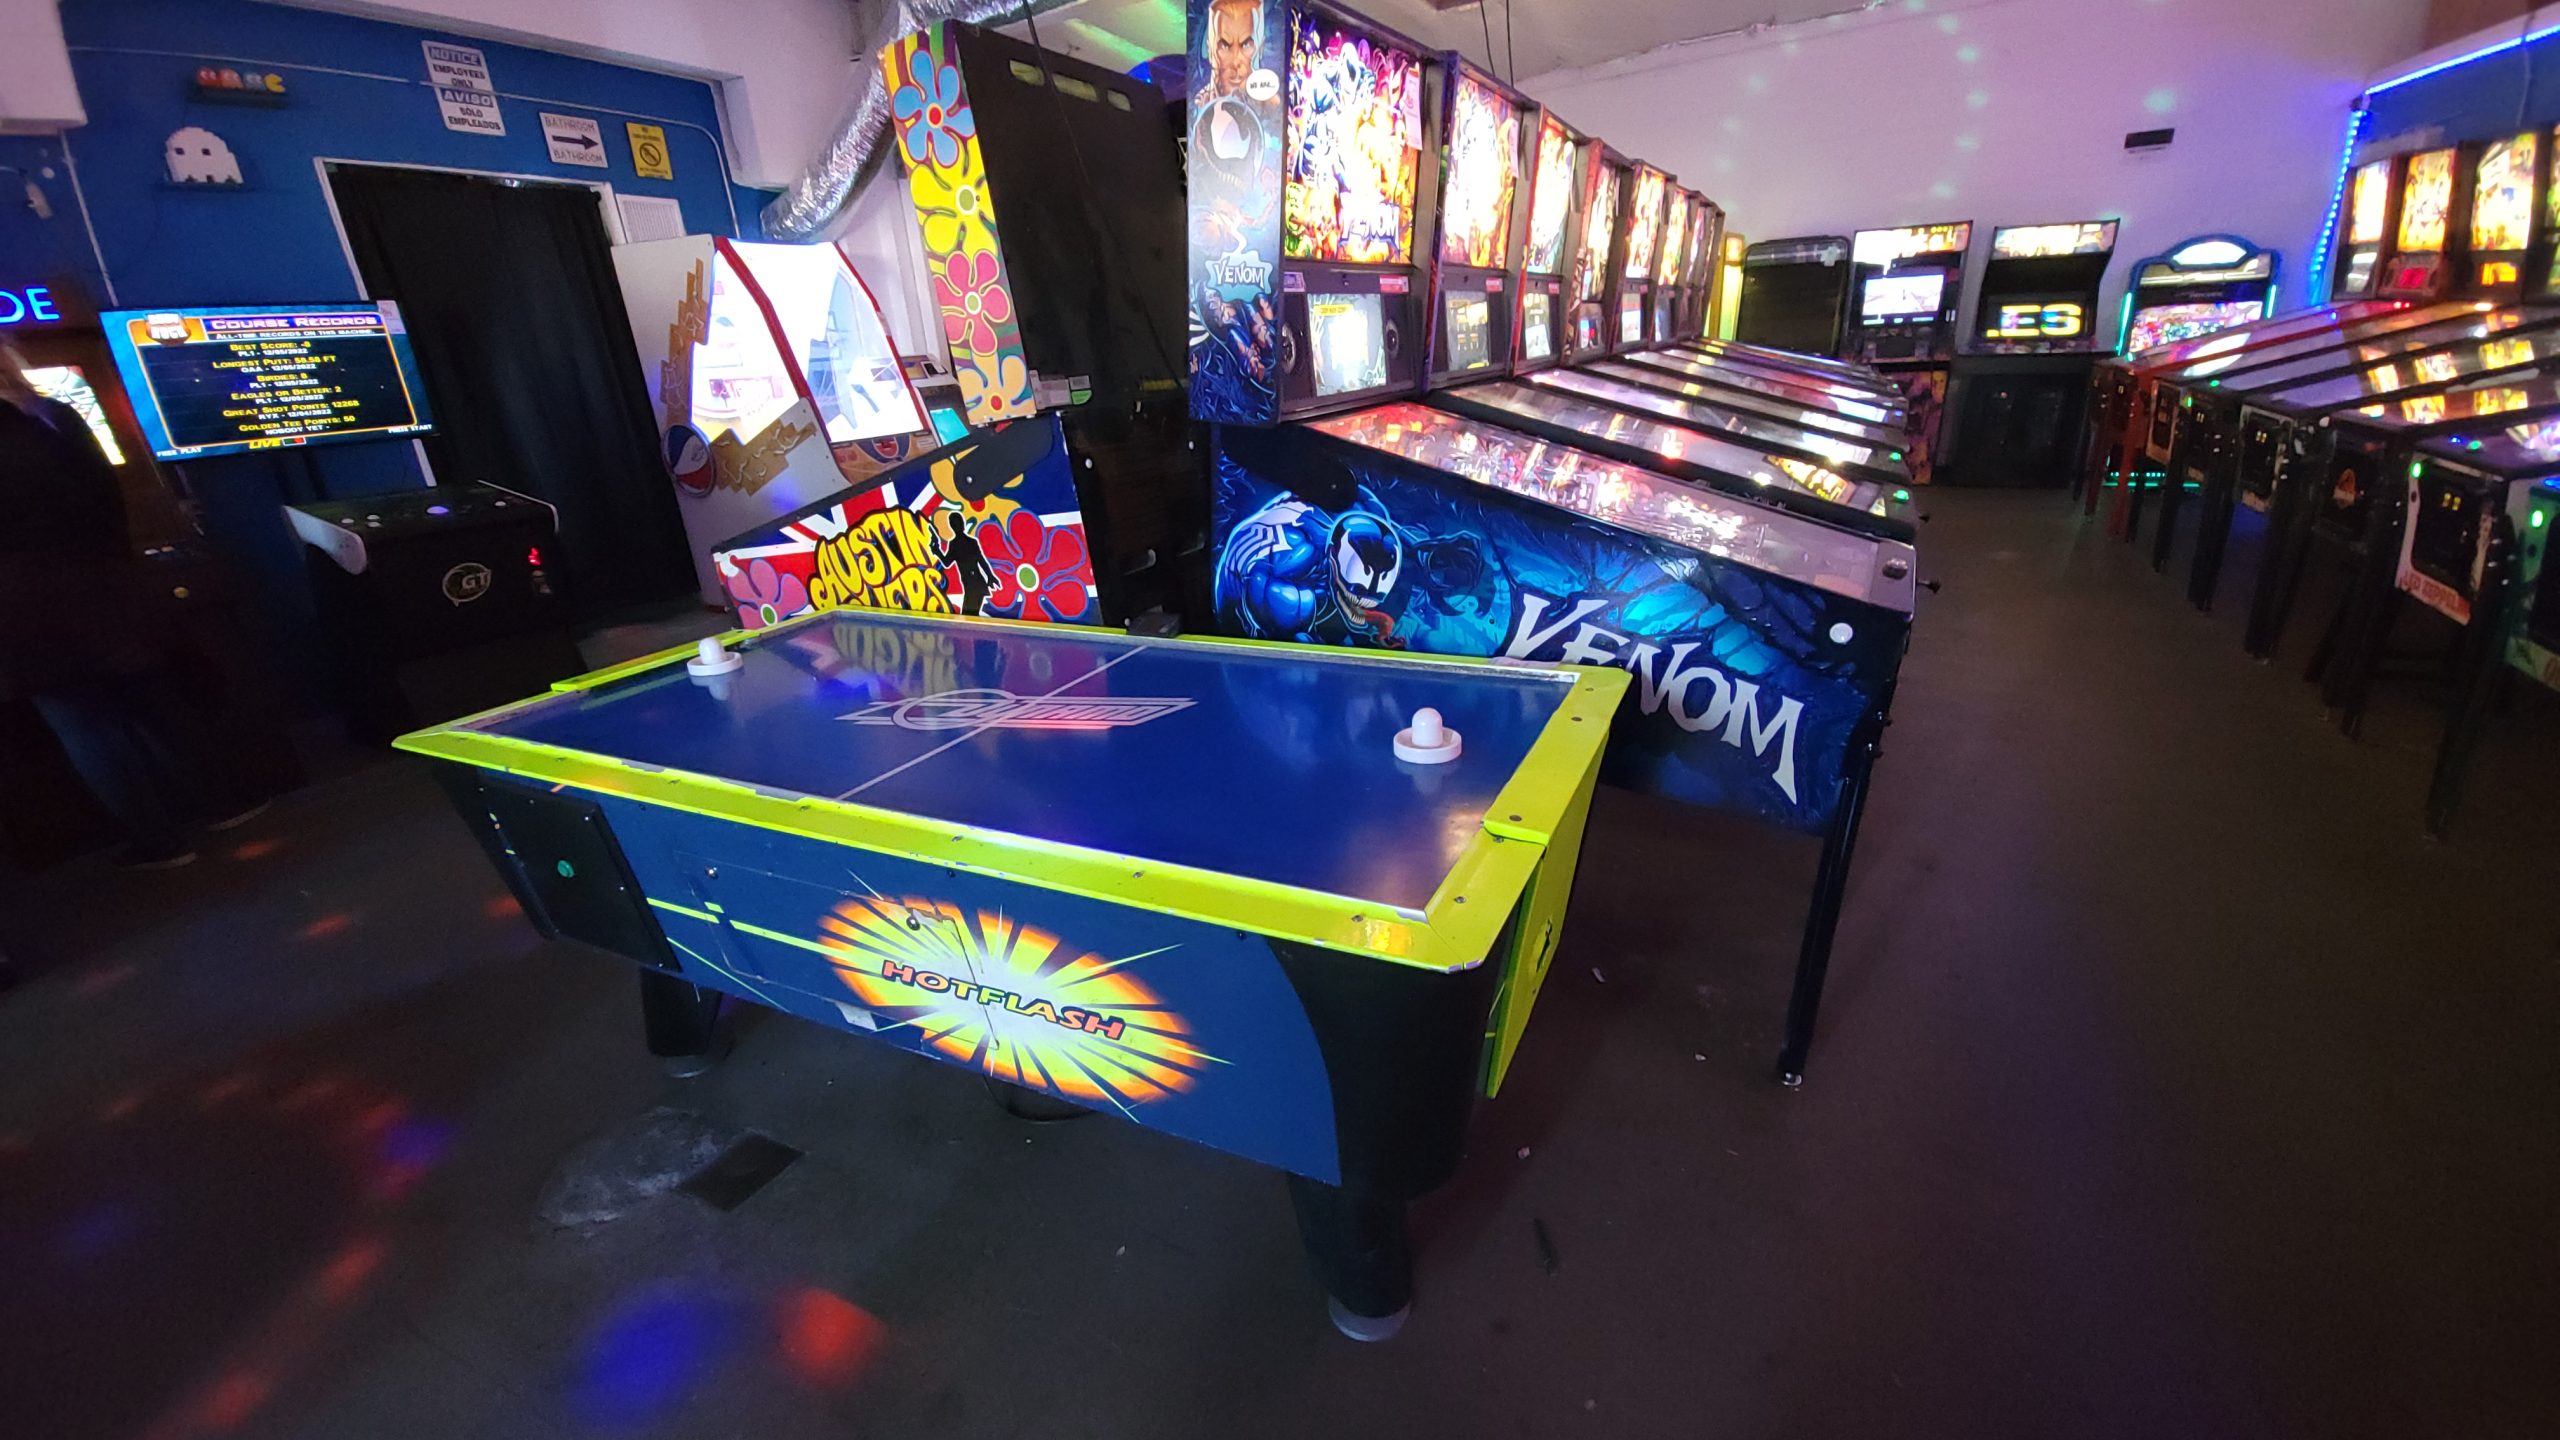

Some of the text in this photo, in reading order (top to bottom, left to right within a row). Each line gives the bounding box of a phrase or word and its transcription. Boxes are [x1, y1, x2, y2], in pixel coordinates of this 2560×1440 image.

[430, 48, 480, 65] NOTICE
[432, 64, 485, 79] EMPLOYEES
[451, 78, 474, 88] ONLY
[444, 90, 491, 105] AVISO
[459, 107, 483, 118] SOLO
[448, 116, 501, 130] EMPLEADOS
[544, 117, 595, 132] BATHROOM
[554, 150, 603, 162] BATHROOM
[1213, 256, 1264, 289] VENOM
[211, 316, 377, 330] COURSE RECORDS
[229, 343, 256, 351] BEST
[260, 342, 298, 350] SCORE:
[212, 360, 260, 369] LONGEST
[323, 355, 336, 363] FT
[256, 373, 299, 382] BIRDIES:
[231, 391, 272, 400] EAGLES
[294, 387, 332, 396] BETTER:
[223, 408, 258, 417] GREAT
[262, 405, 289, 414] SHOT
[292, 403, 330, 412] POINTS:
[238, 415, 355, 432] GOLDEN TEE POINTS: 50
[265, 427, 303, 436] NOBODY
[307, 424, 324, 432] YET
[410, 423, 433, 432] START
[249, 438, 281, 449] LIVE
[156, 447, 203, 457] FREE PLAY
[810, 508, 938, 612] AUSTIN
[1505, 593, 1805, 805] VENOM
[882, 959, 1126, 1041] HOTFLASH
